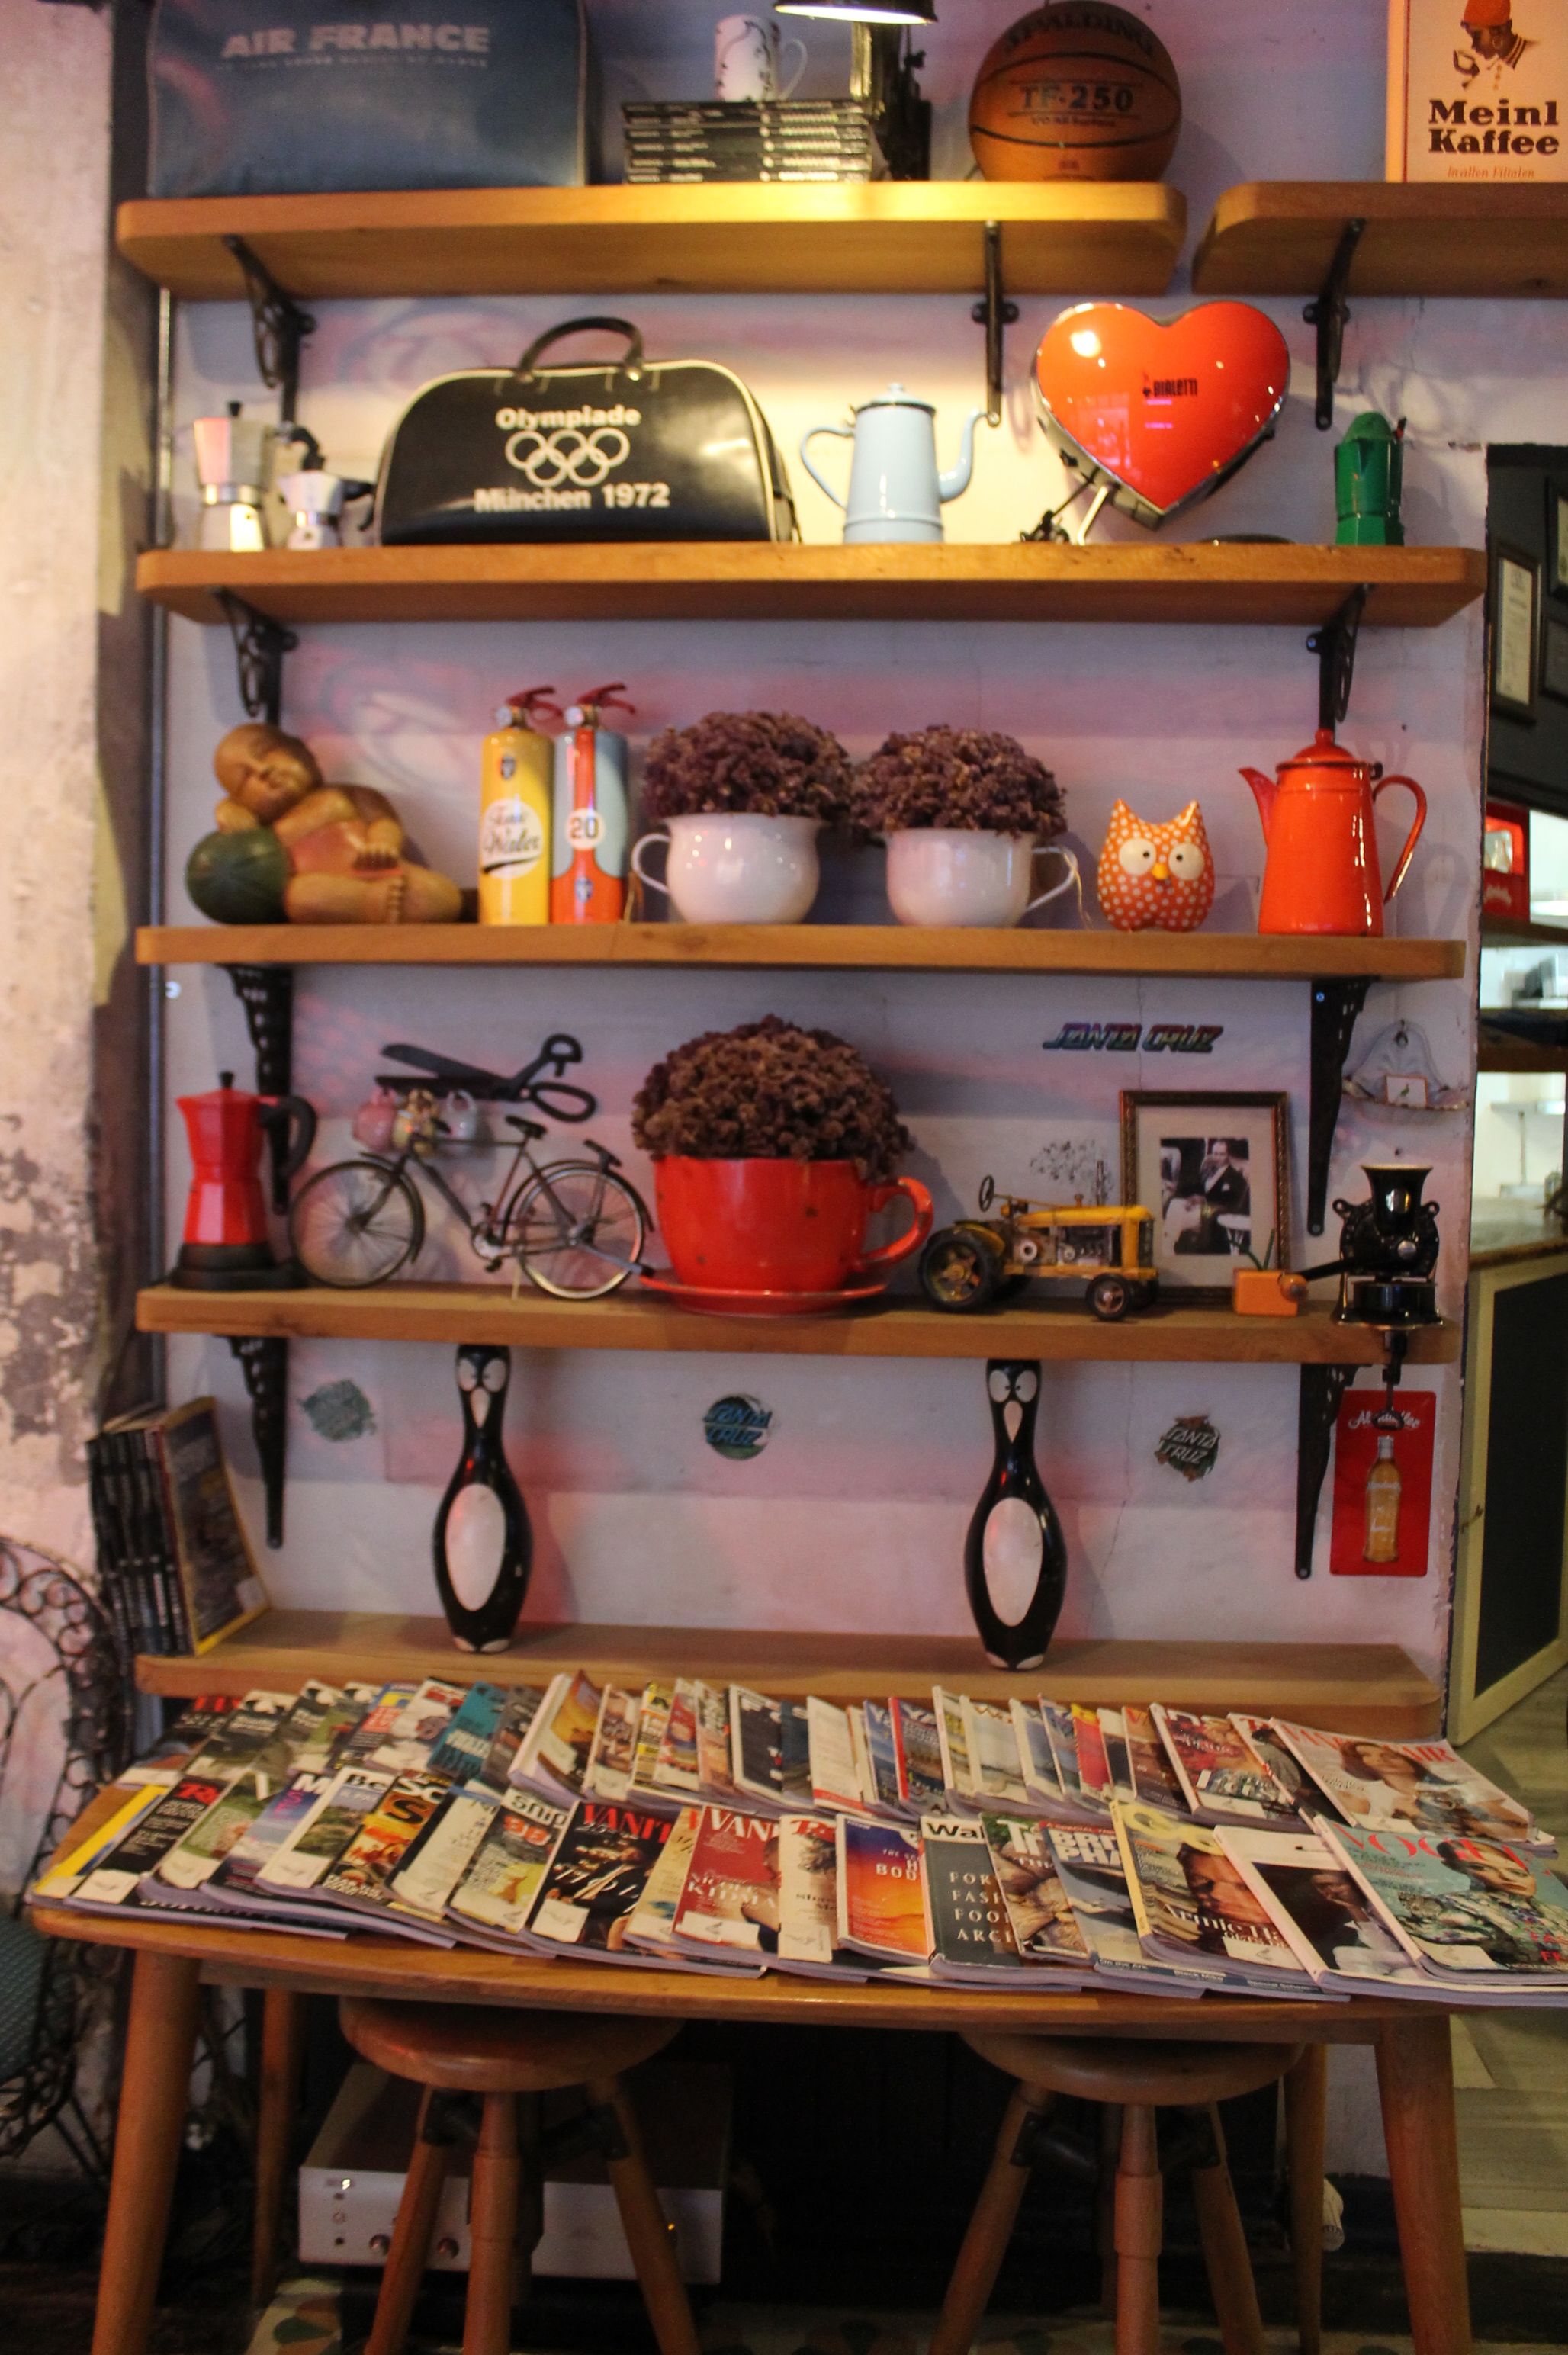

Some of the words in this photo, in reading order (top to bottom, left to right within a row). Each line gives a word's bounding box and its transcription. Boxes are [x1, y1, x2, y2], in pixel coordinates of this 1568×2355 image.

[221, 27, 297, 58] AIR
[308, 24, 490, 53] FRANCE
[1428, 98, 1560, 127] Meinl
[1428, 128, 1560, 155] Kaffee
[1152, 378, 1198, 397] BIALETTI
[495, 403, 642, 430] Olympiade
[474, 486, 592, 512] München
[602, 482, 670, 509] 1972
[570, 817, 599, 840] 20
[1043, 1023, 1142, 1050] SANTA
[1142, 1024, 1223, 1053] CRUZ
[949, 1871, 991, 1885] FOR
